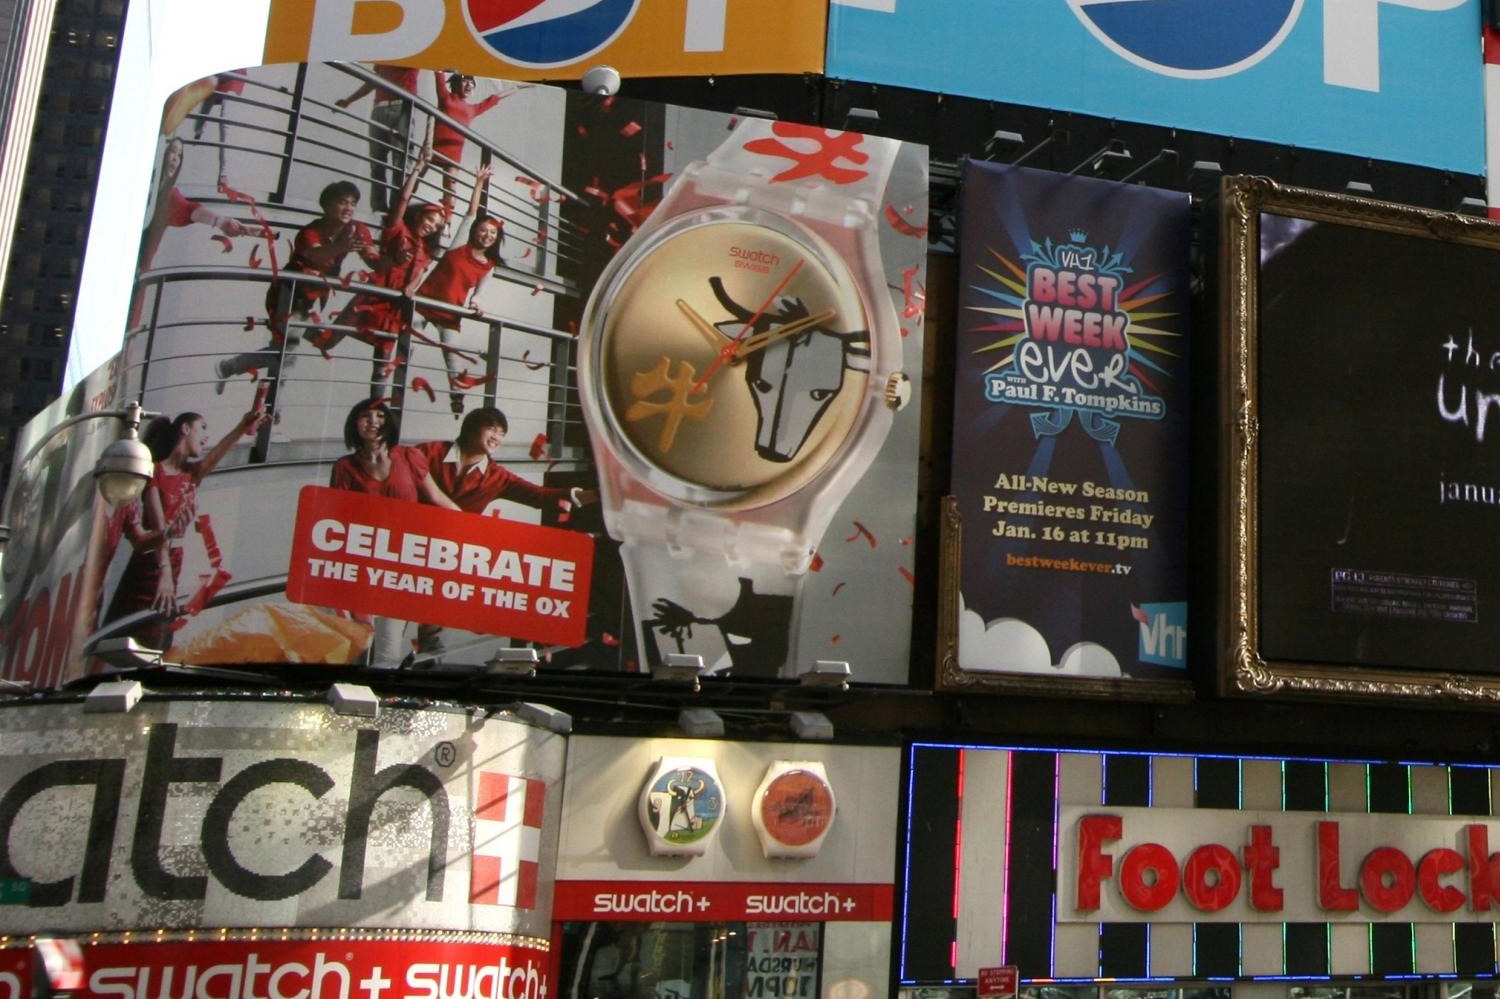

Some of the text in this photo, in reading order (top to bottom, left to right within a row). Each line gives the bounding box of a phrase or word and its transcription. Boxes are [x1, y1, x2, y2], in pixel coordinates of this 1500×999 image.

[729, 246, 780, 266] swatch
[1032, 267, 1118, 311] BEST
[1028, 303, 1126, 351] WEEK
[991, 379, 1161, 414] Paul F. Tompkins
[994, 472, 1149, 503] All-New Season
[983, 495, 1155, 529] Premieres Friday
[992, 520, 1149, 550] Jan. 16 at 11pm
[310, 518, 577, 592] CELEBRATE
[1006, 553, 1133, 576] bestweekever.tv
[308, 557, 571, 619] THE YEAR OF THE OX
[1074, 813, 1285, 915] Foot
